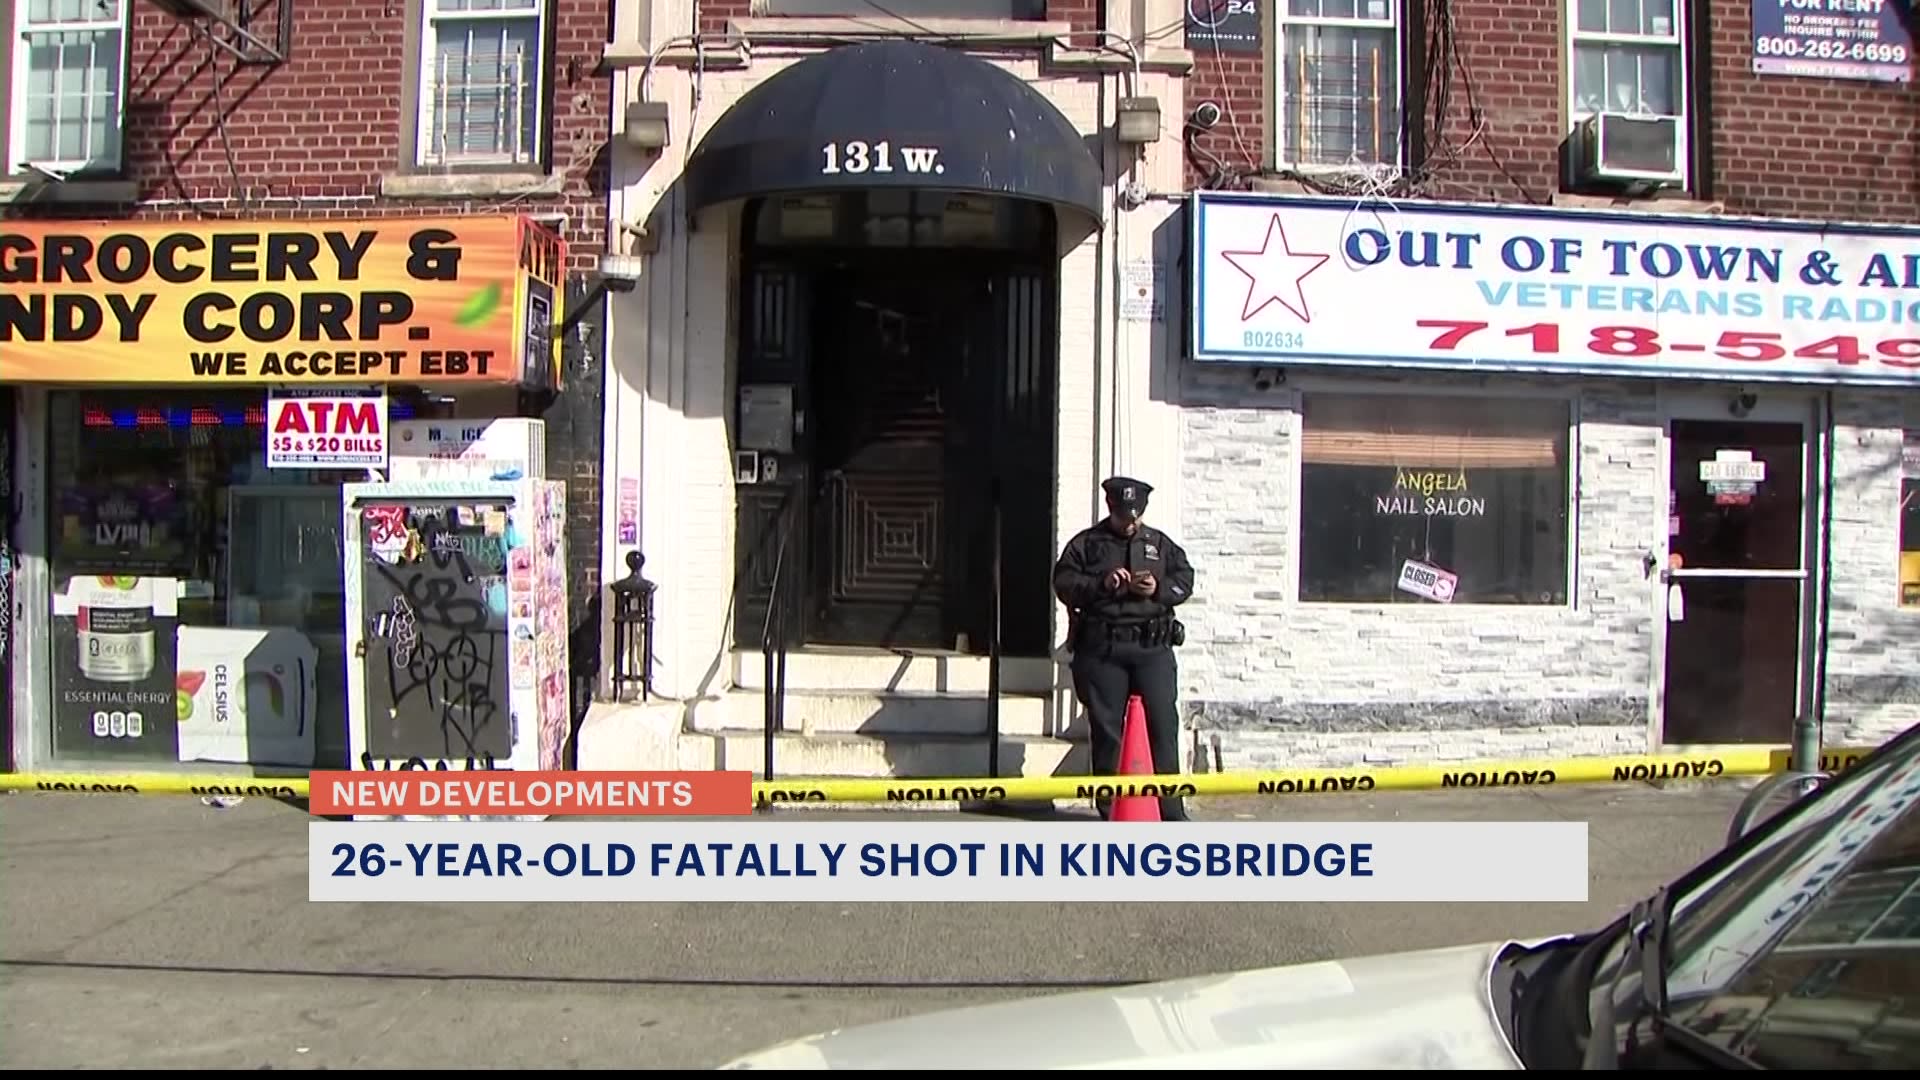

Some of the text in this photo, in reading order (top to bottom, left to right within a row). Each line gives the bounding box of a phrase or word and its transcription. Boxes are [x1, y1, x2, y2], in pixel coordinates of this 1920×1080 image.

[1227, 0, 1256, 14] 24
[1778, 0, 1885, 14] FOR RENT
[1784, 15, 1801, 25] NO
[1783, 25, 1879, 40] INQUIRE WITHIN
[1757, 37, 1907, 64] 800-262-6699
[822, 141, 893, 173] 131
[0, 229, 462, 283] GROCERY &
[1346, 228, 1480, 269] OUT
[1502, 236, 1583, 274] OF
[1602, 241, 1783, 283] TOWN
[1799, 250, 1842, 287] &
[1476, 280, 1763, 320] VETERANS
[0, 291, 430, 342] NDY CORP.
[1242, 331, 1304, 349] B02634
[191, 350, 494, 376] WE ACCEPT EBT
[274, 402, 380, 434] ATM
[273, 437, 382, 452] $5 & $20 BILLS
[1396, 473, 1467, 495] ANGELA
[1376, 497, 1485, 516] NAIL SALON
[1403, 565, 1436, 587] CLOSED
[65, 692, 172, 705] ESSENTIAL ENERGY
[215, 664, 229, 722] CELSIUS
[1441, 769, 1556, 789] CAUTION
[1612, 759, 1724, 781] CAUTION
[887, 786, 1006, 801] CAUTION
[1076, 784, 1197, 799] CAUTION
[1257, 776, 1375, 795] CAUTION
[757, 790, 826, 803] CAUT
